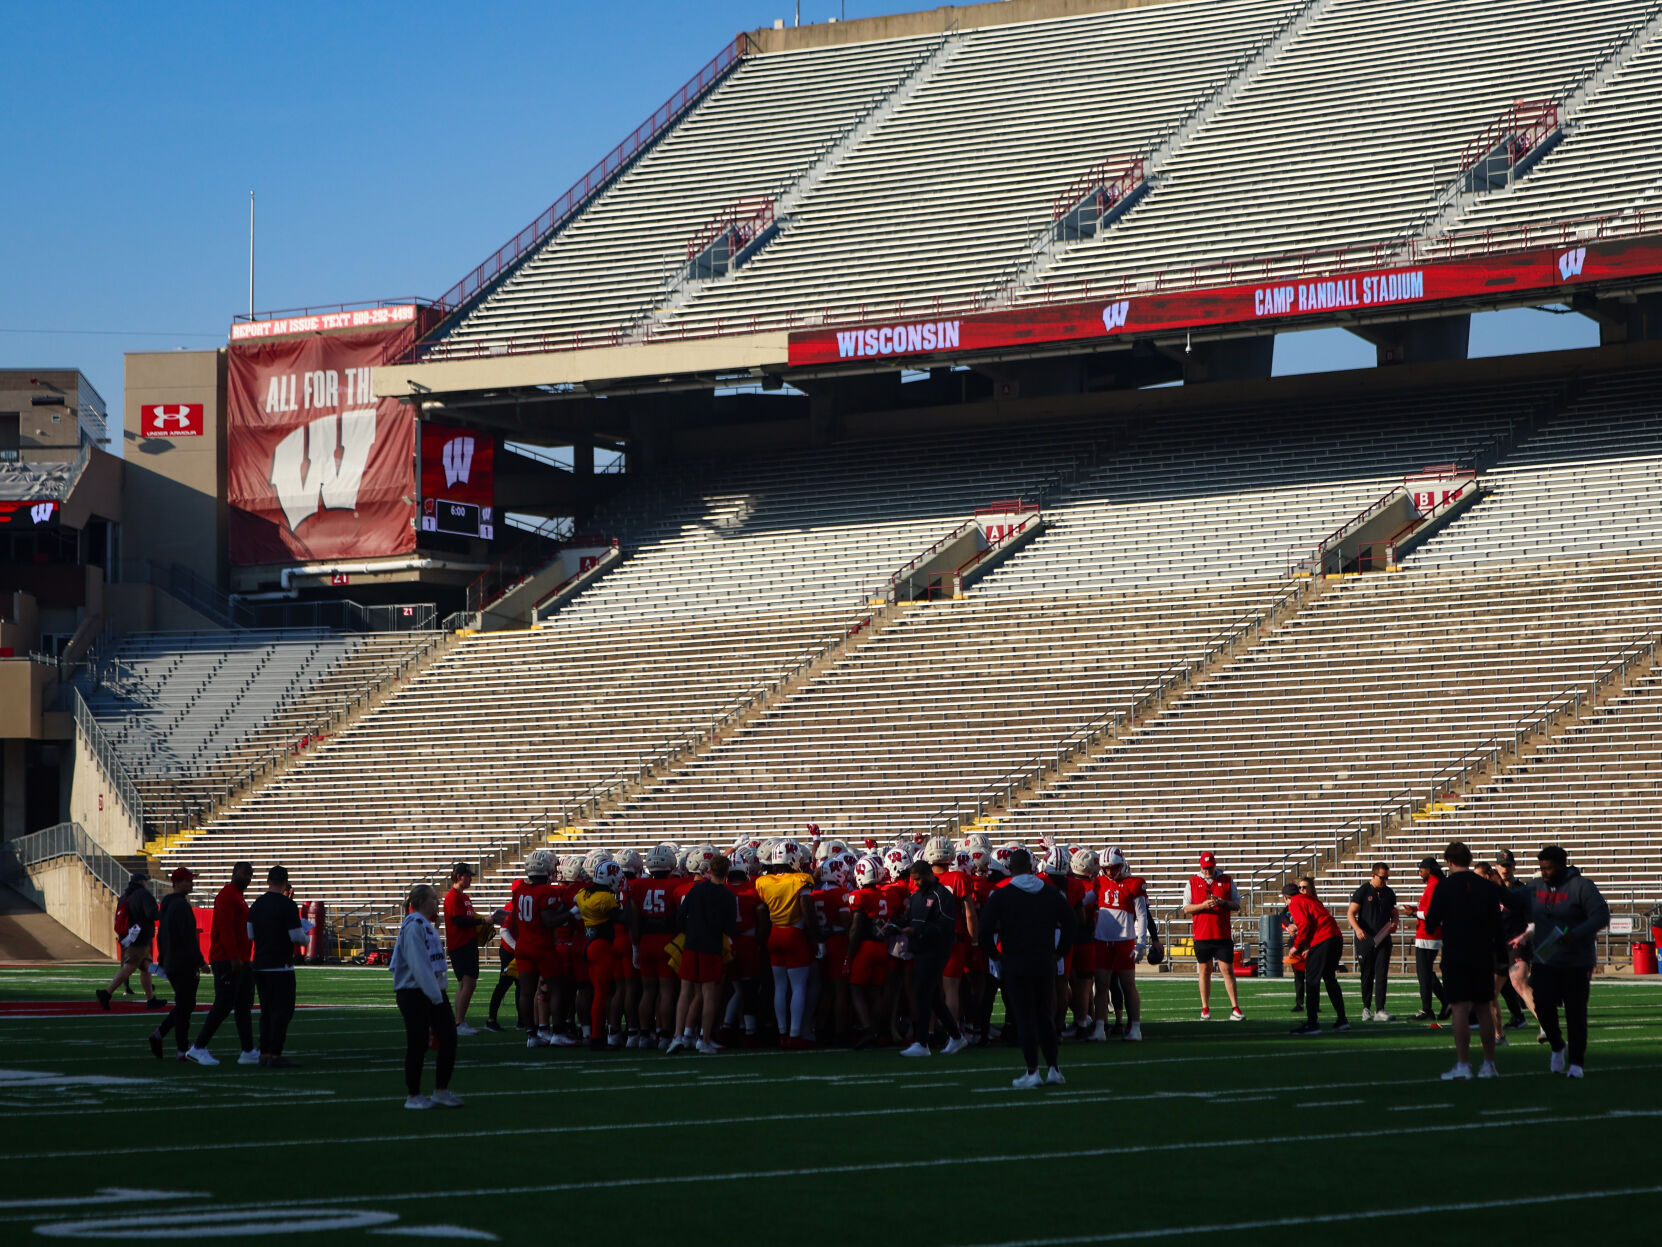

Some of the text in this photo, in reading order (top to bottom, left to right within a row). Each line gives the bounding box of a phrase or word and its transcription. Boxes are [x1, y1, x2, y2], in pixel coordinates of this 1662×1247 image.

[1254, 271, 1424, 316] CAMP RANDALL STADIUM
[233, 323, 272, 338] REPORT
[274, 322, 288, 335] AN
[321, 313, 351, 329] TEXT
[836, 320, 960, 358] WISCONSIN
[265, 374, 299, 413] ALL
[304, 370, 339, 410] FOR
[169, 429, 197, 437] ARMOUR
[270, 409, 376, 533] W
[442, 436, 475, 489] W
[450, 505, 466, 517] 6:00
[1419, 493, 1429, 505] B
[30, 502, 54, 525] W
[990, 526, 1000, 539] A
[643, 889, 666, 914] 45
